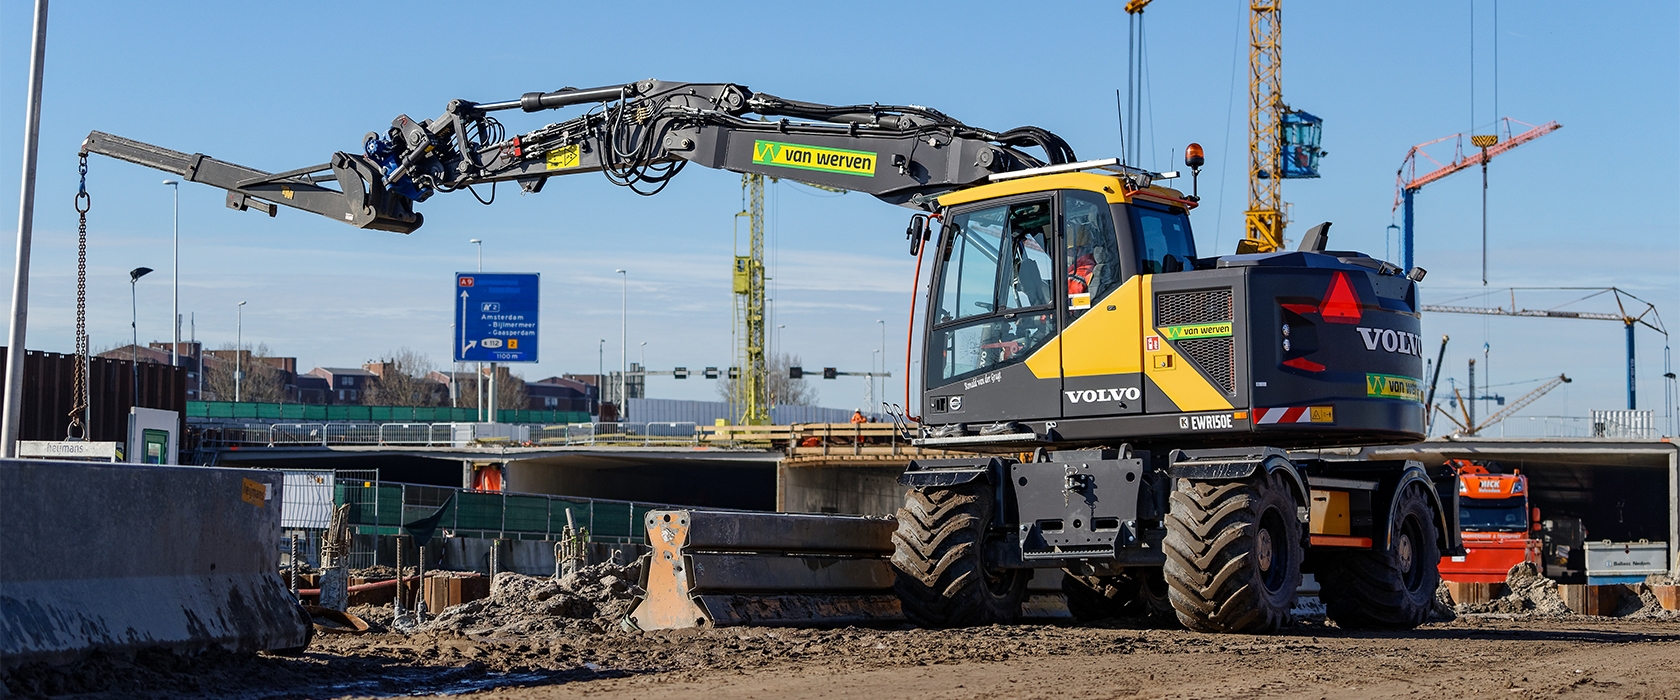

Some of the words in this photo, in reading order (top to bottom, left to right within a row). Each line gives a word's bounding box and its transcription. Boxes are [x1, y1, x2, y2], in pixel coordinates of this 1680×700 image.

[785, 149, 812, 163] van
[817, 152, 871, 170] werven
[493, 321, 536, 329] Bijlmermeer
[1200, 325, 1230, 334] werven
[1388, 380, 1405, 393] van
[1065, 387, 1141, 404] VOLVO
[1191, 414, 1233, 430] EWR150E
